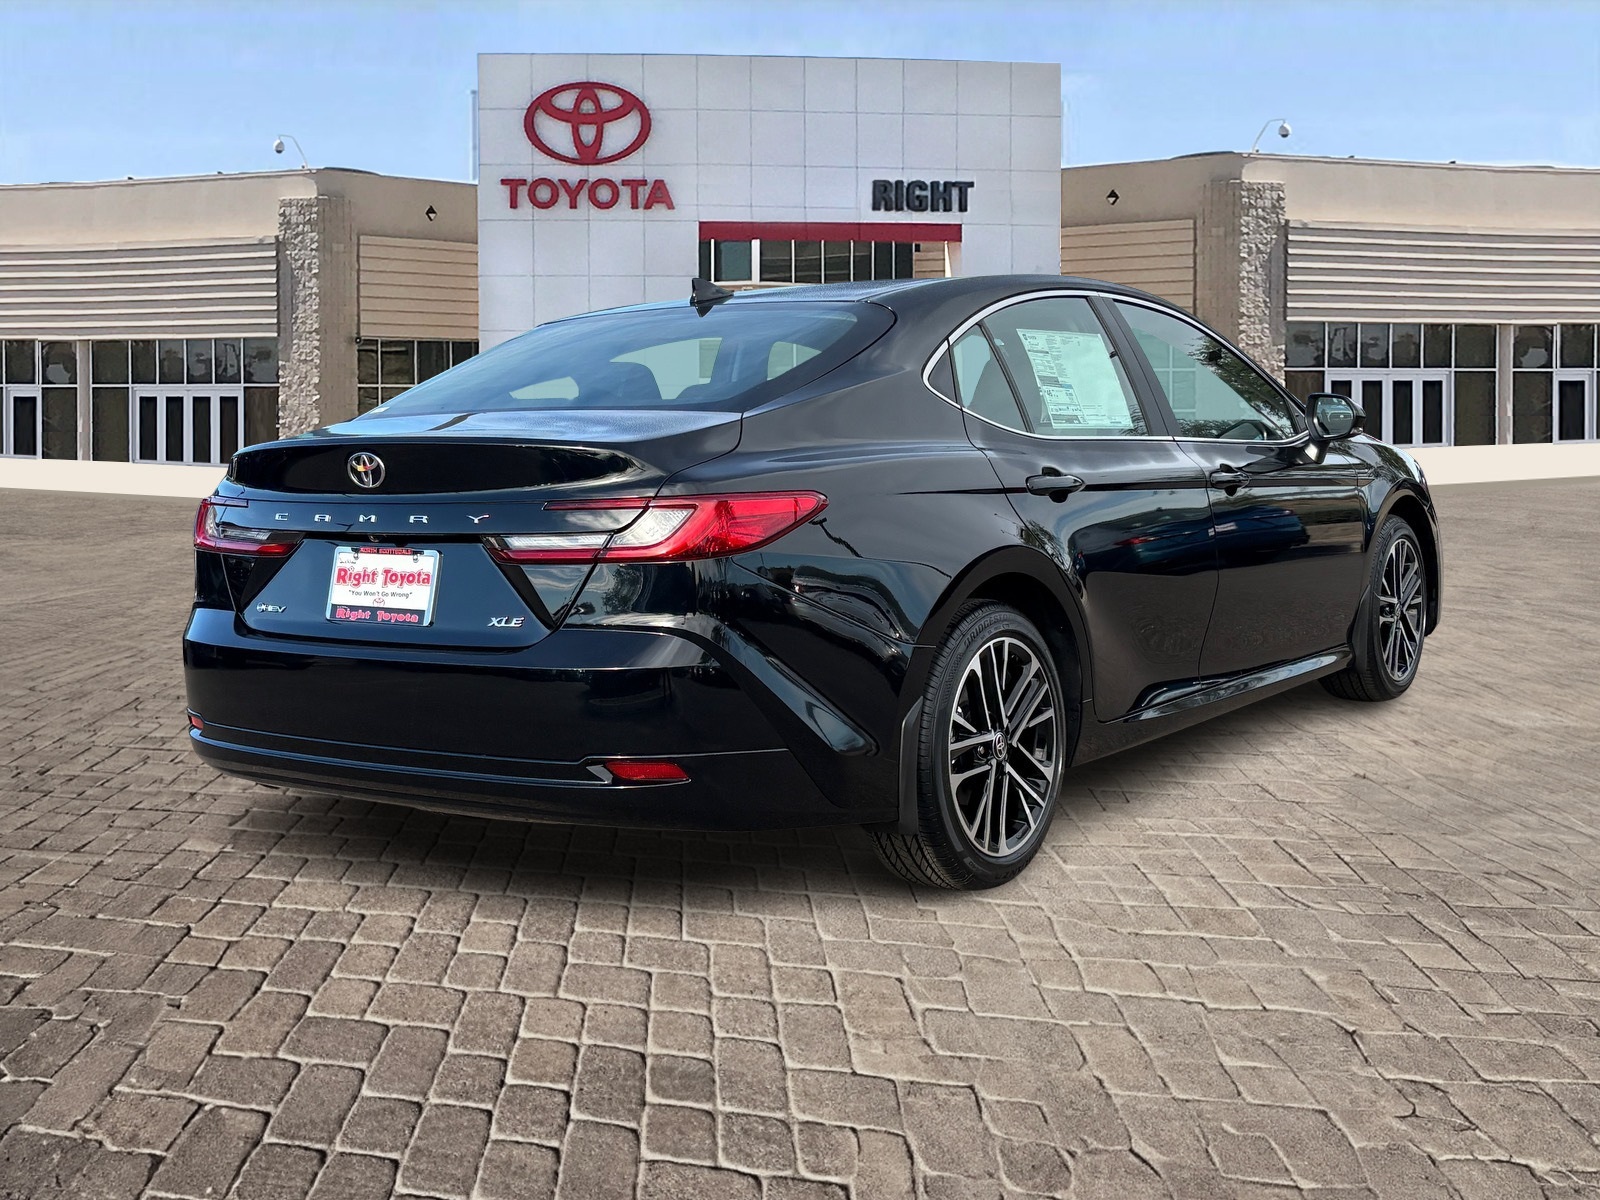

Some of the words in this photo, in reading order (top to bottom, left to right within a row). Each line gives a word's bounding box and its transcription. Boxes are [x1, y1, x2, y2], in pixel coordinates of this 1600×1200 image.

[500, 178, 675, 210] TOYOTA
[871, 179, 975, 212] RIGHT
[274, 512, 491, 525] CAMRY
[335, 567, 378, 588] Right
[382, 567, 432, 588] Toyota
[335, 608, 371, 621] Right
[377, 610, 419, 623] Toyota
[487, 616, 526, 628] XLE
